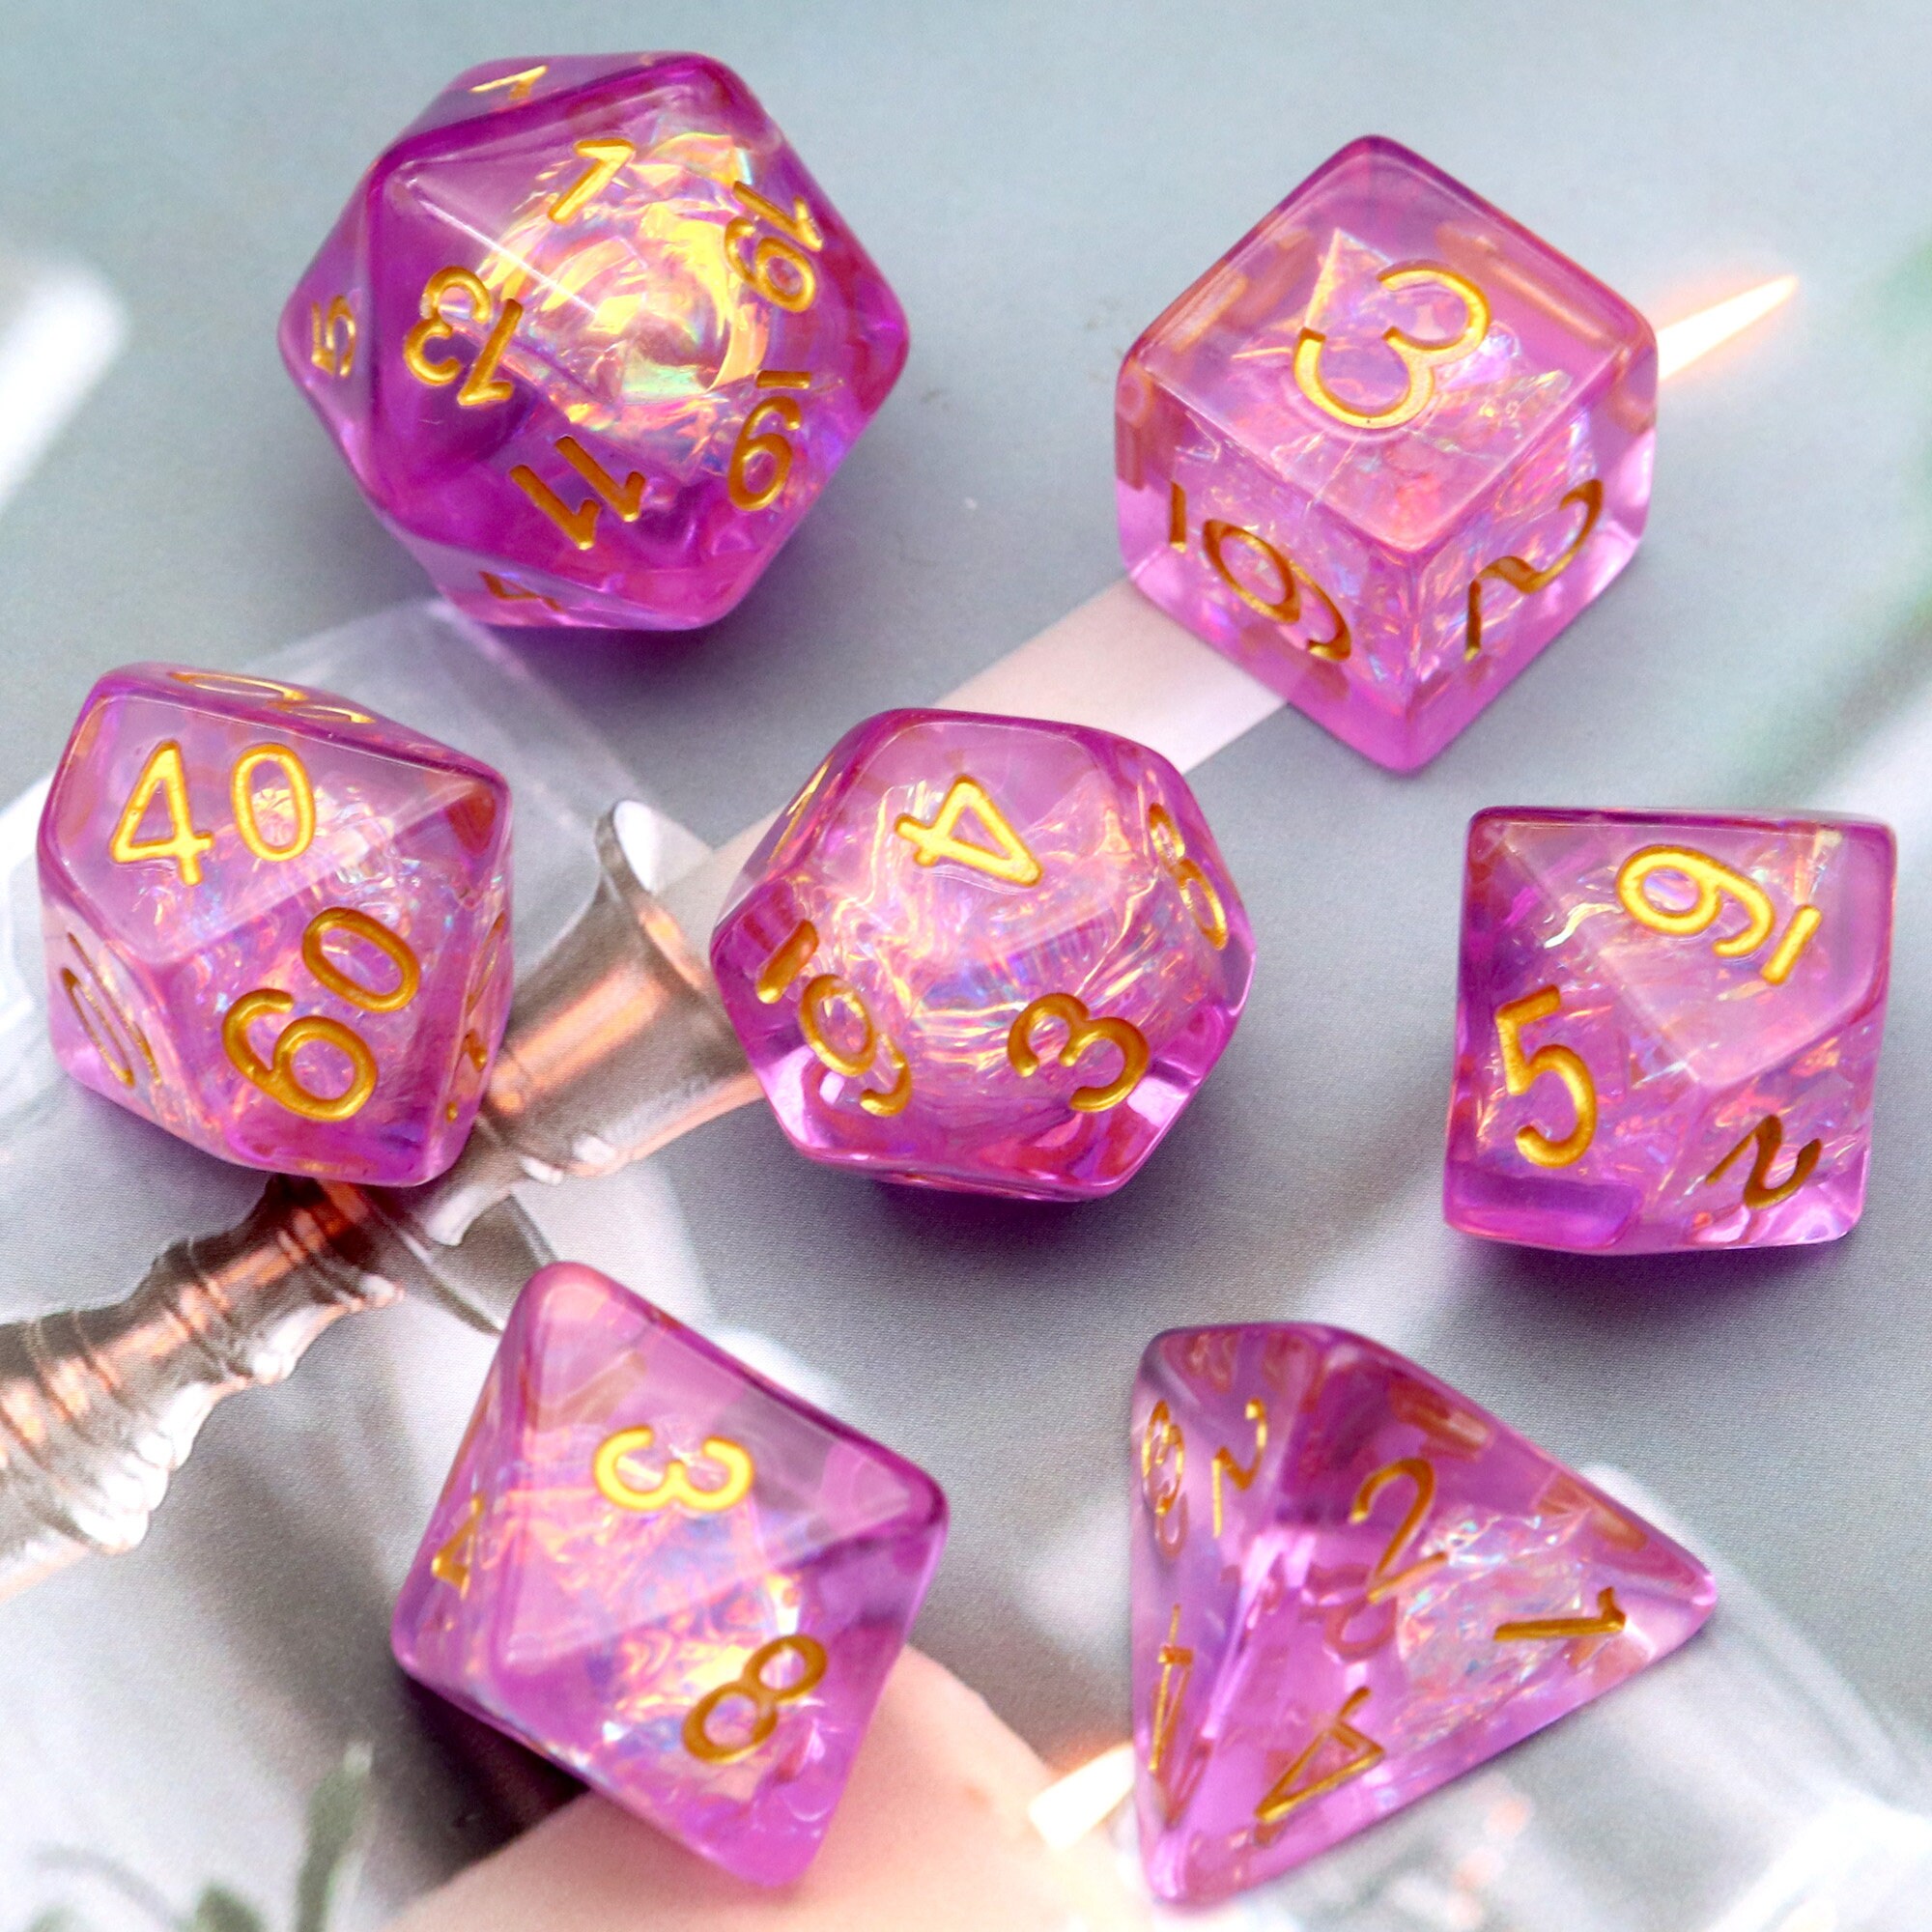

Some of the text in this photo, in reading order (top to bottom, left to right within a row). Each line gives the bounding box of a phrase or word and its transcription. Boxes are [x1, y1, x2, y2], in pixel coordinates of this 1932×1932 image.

[723, 180, 824, 314] 19
[402, 265, 524, 407] 13
[1293, 258, 1492, 430] 3
[508, 434, 647, 553] 11
[1463, 477, 1604, 662] 2
[109, 740, 316, 887] 40
[895, 774, 1043, 887] 4
[221, 906, 421, 1122] 60
[1006, 991, 1151, 1114] 3
[1493, 983, 1598, 1169] 5
[1705, 1114, 1823, 1209] 2
[593, 1425, 753, 1513] 3
[1350, 1457, 1450, 1605] 2
[1494, 1585, 1627, 1642] 1
[680, 1633, 829, 1766] 8
[1255, 1686, 1387, 1825] 4
